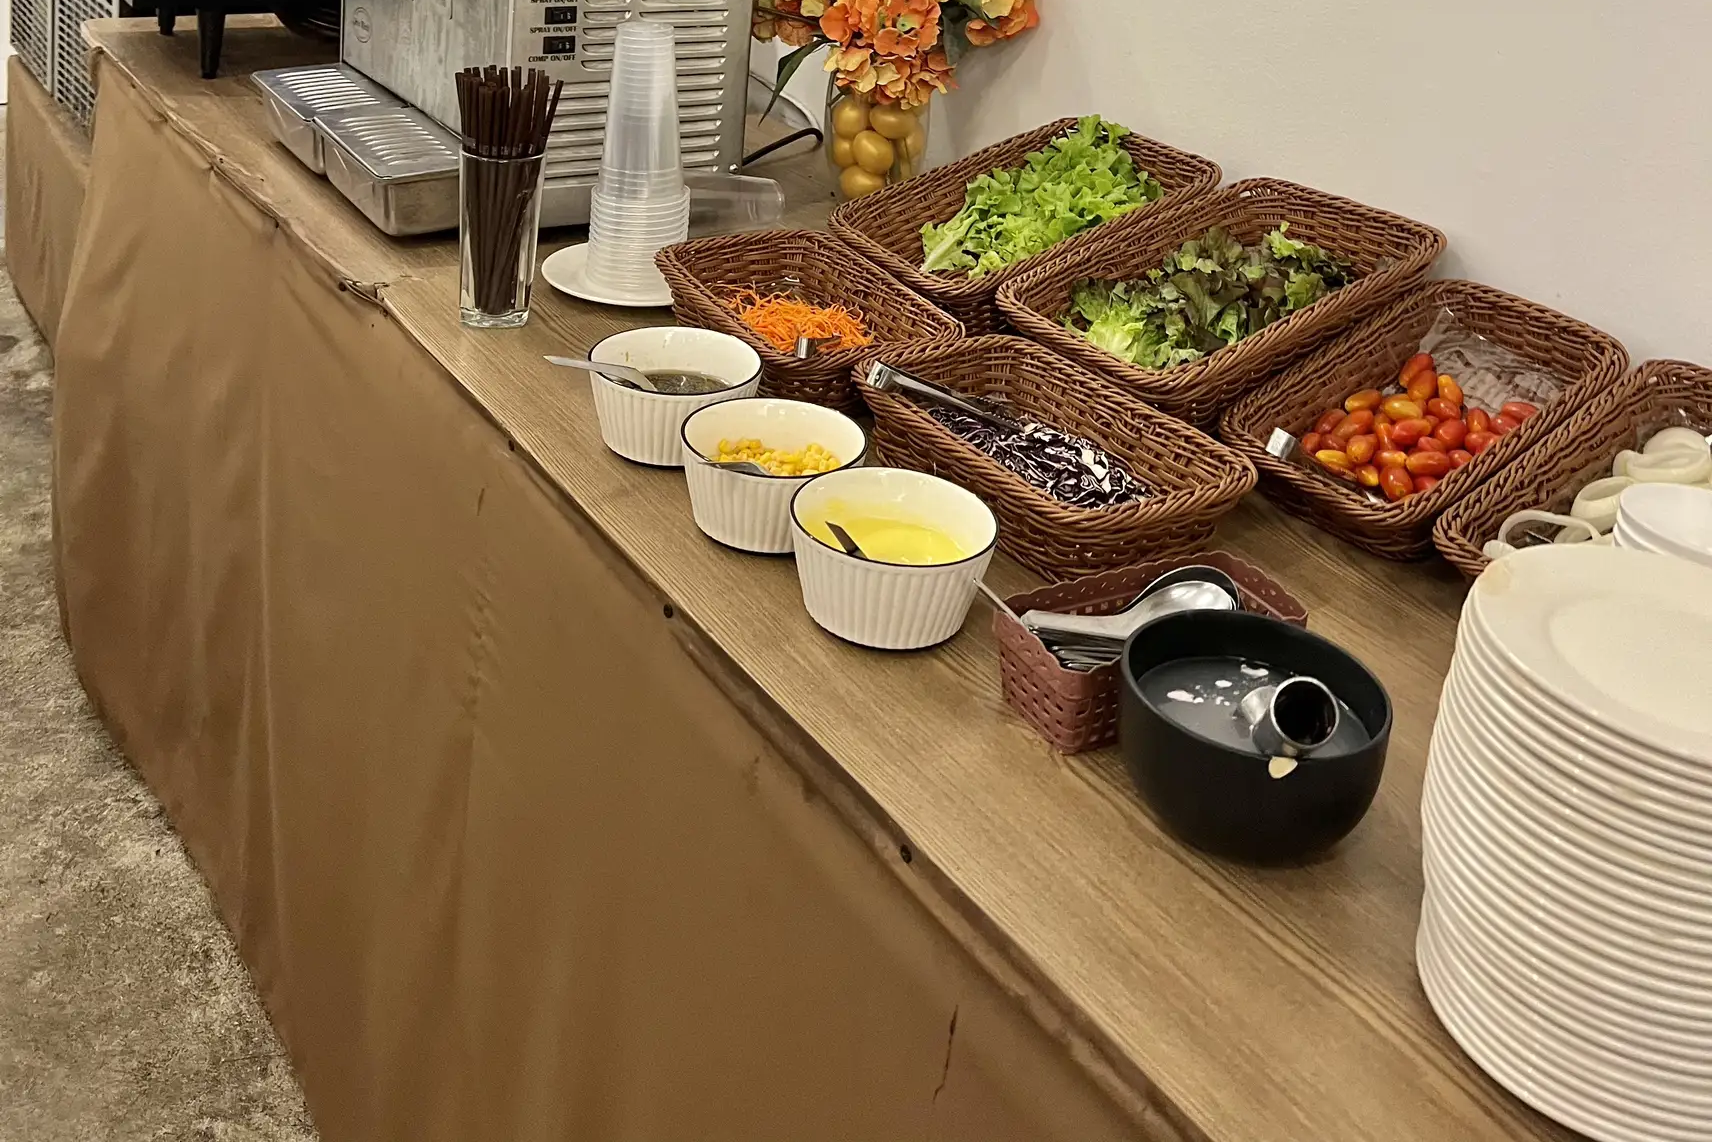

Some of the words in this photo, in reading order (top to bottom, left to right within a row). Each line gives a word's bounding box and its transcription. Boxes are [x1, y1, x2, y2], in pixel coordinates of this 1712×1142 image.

[529, 26, 551, 34] SPRAY
[553, 25, 577, 33] ON/OFF
[551, 54, 576, 62] ON/OFF
